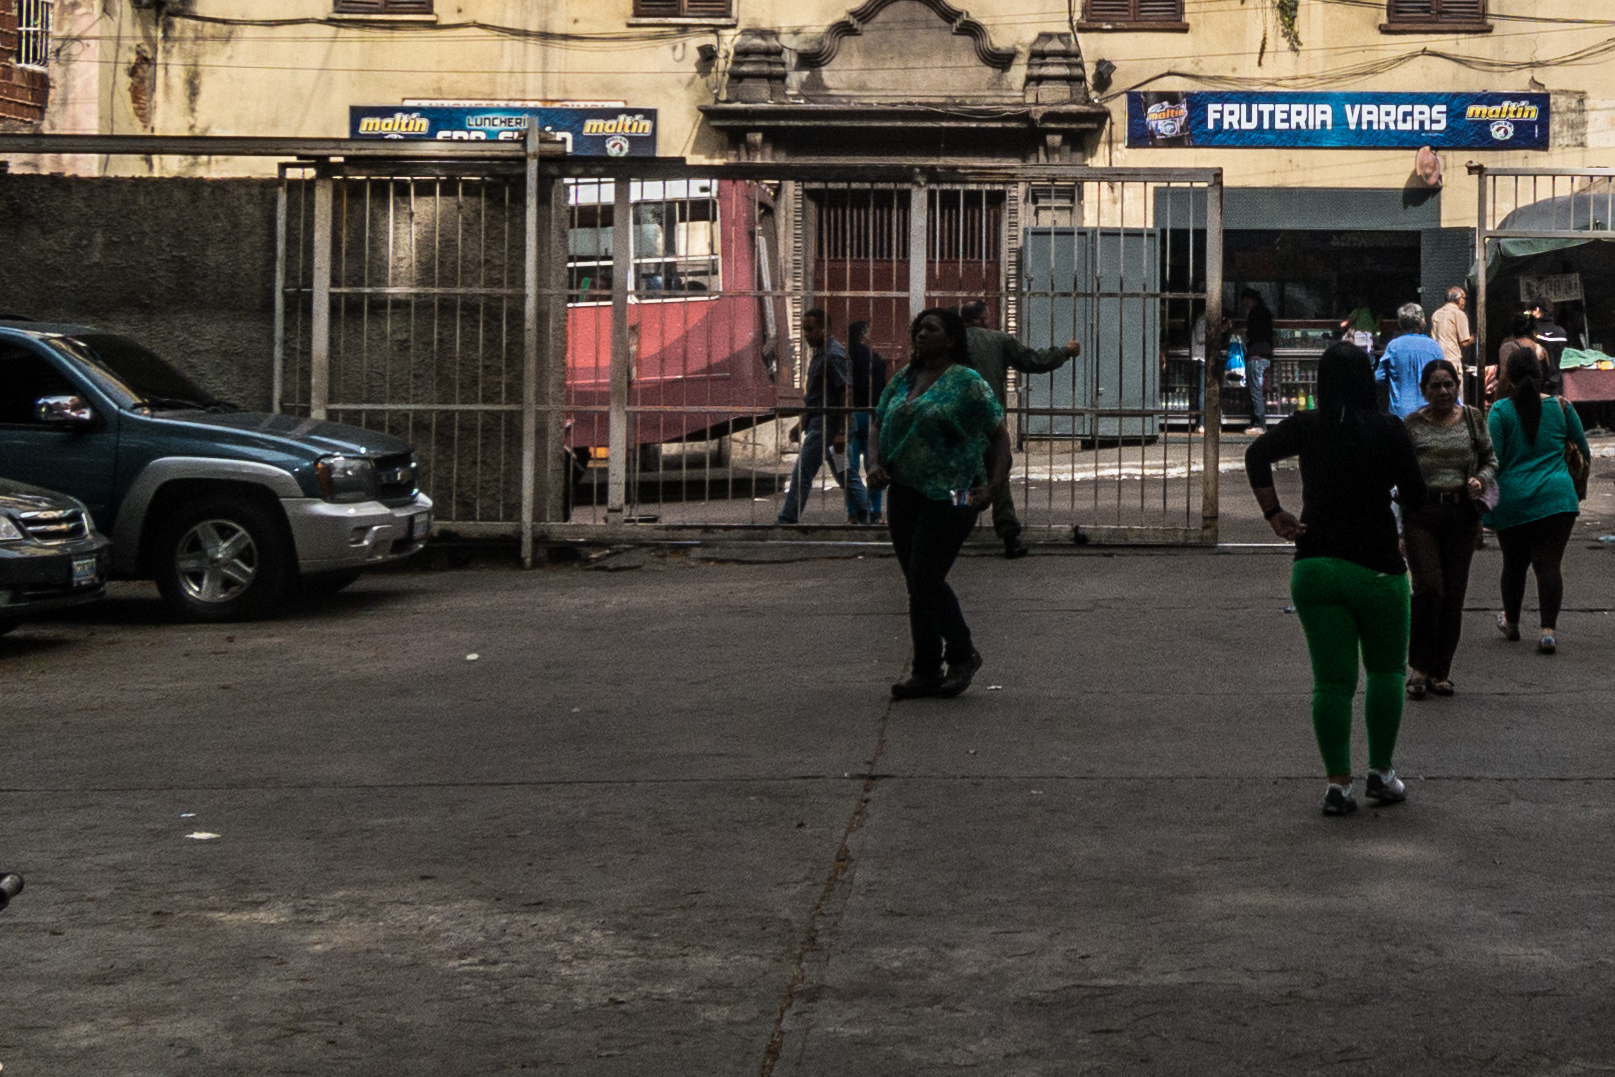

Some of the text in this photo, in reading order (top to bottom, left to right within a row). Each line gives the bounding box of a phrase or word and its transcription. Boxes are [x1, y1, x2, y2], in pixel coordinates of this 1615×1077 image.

[466, 114, 529, 128] LUNCHERÍ
[1207, 103, 1447, 131] FRUTERIA VARGAS
